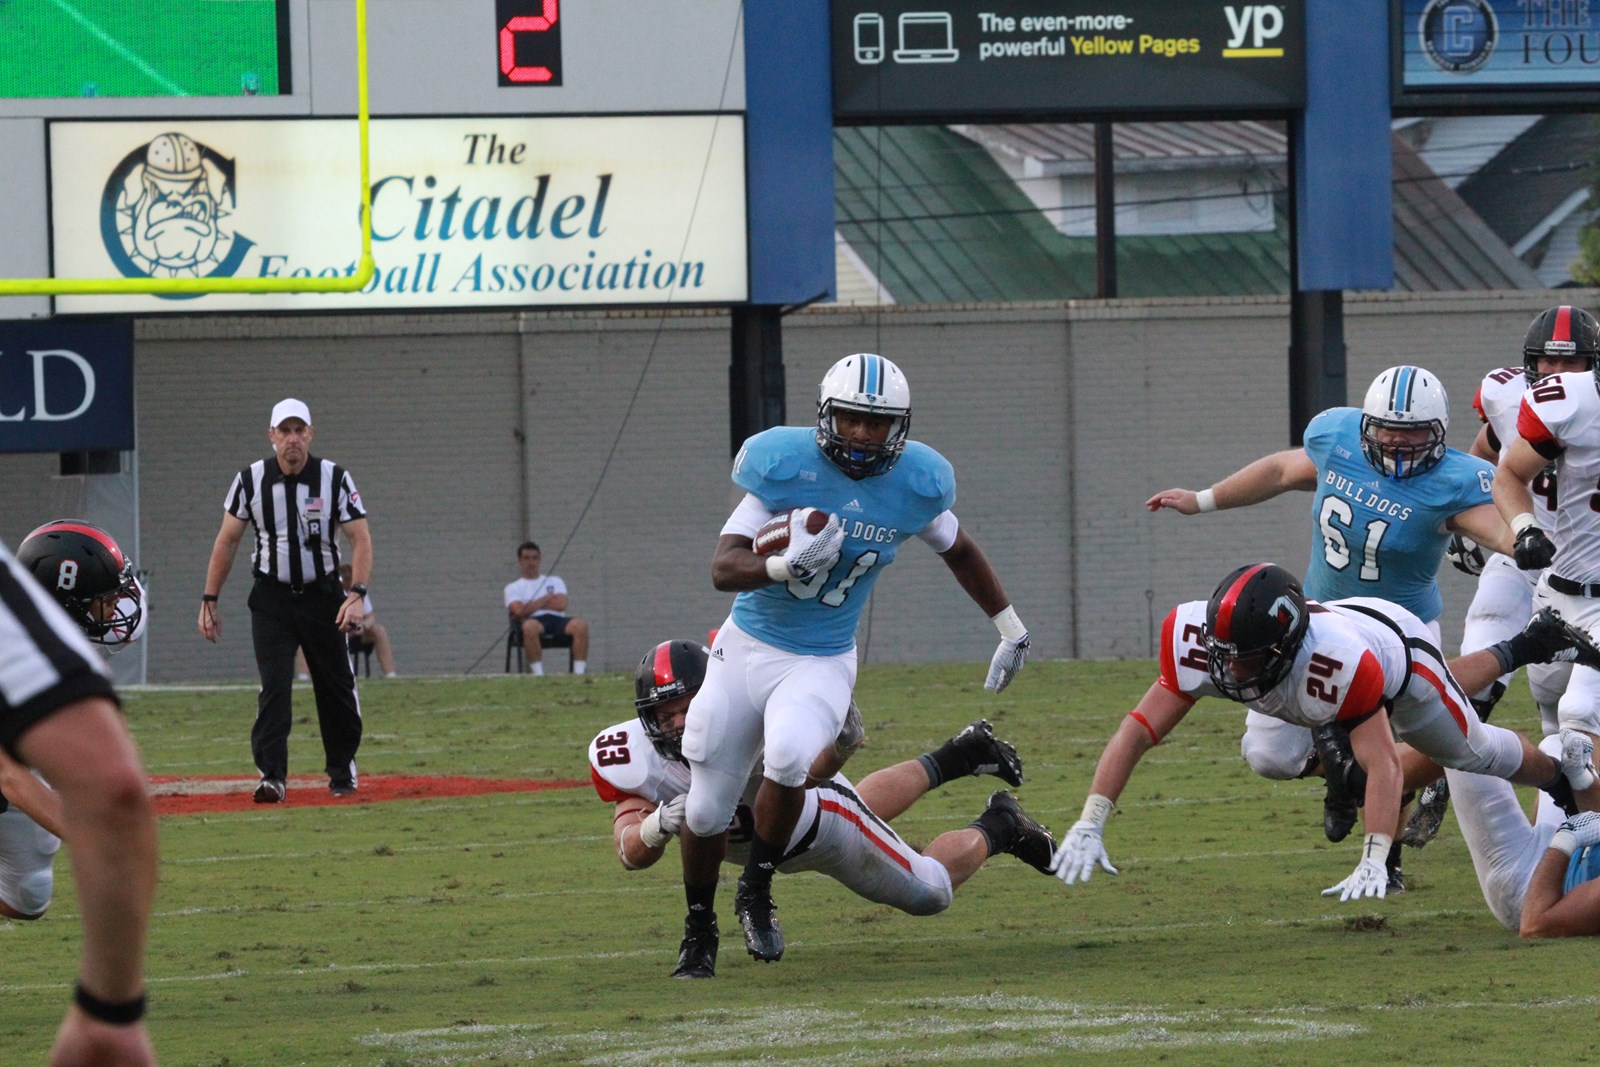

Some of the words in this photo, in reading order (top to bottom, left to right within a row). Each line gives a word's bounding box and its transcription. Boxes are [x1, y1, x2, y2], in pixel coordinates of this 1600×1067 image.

[978, 13, 1016, 31] The
[1020, 14, 1134, 31] even-more-
[1223, 4, 1284, 48] yp
[1518, 0, 1592, 28] THE
[500, 0, 558, 82] 2
[979, 36, 1066, 61] powerful
[1070, 35, 1134, 56] Yellow
[1139, 34, 1201, 57] Pages
[1520, 32, 1600, 64] FOU
[463, 133, 526, 165] The
[358, 173, 613, 241] Citadel
[452, 249, 705, 292] Association
[1325, 469, 1413, 522] BULLDOGS
[309, 522, 320, 535] R
[841, 517, 898, 544] LDOGS
[1319, 494, 1390, 583] 61
[57, 559, 79, 591] 8
[1180, 623, 1209, 673] 24
[1306, 652, 1344, 705] 24
[595, 730, 632, 768] 33
